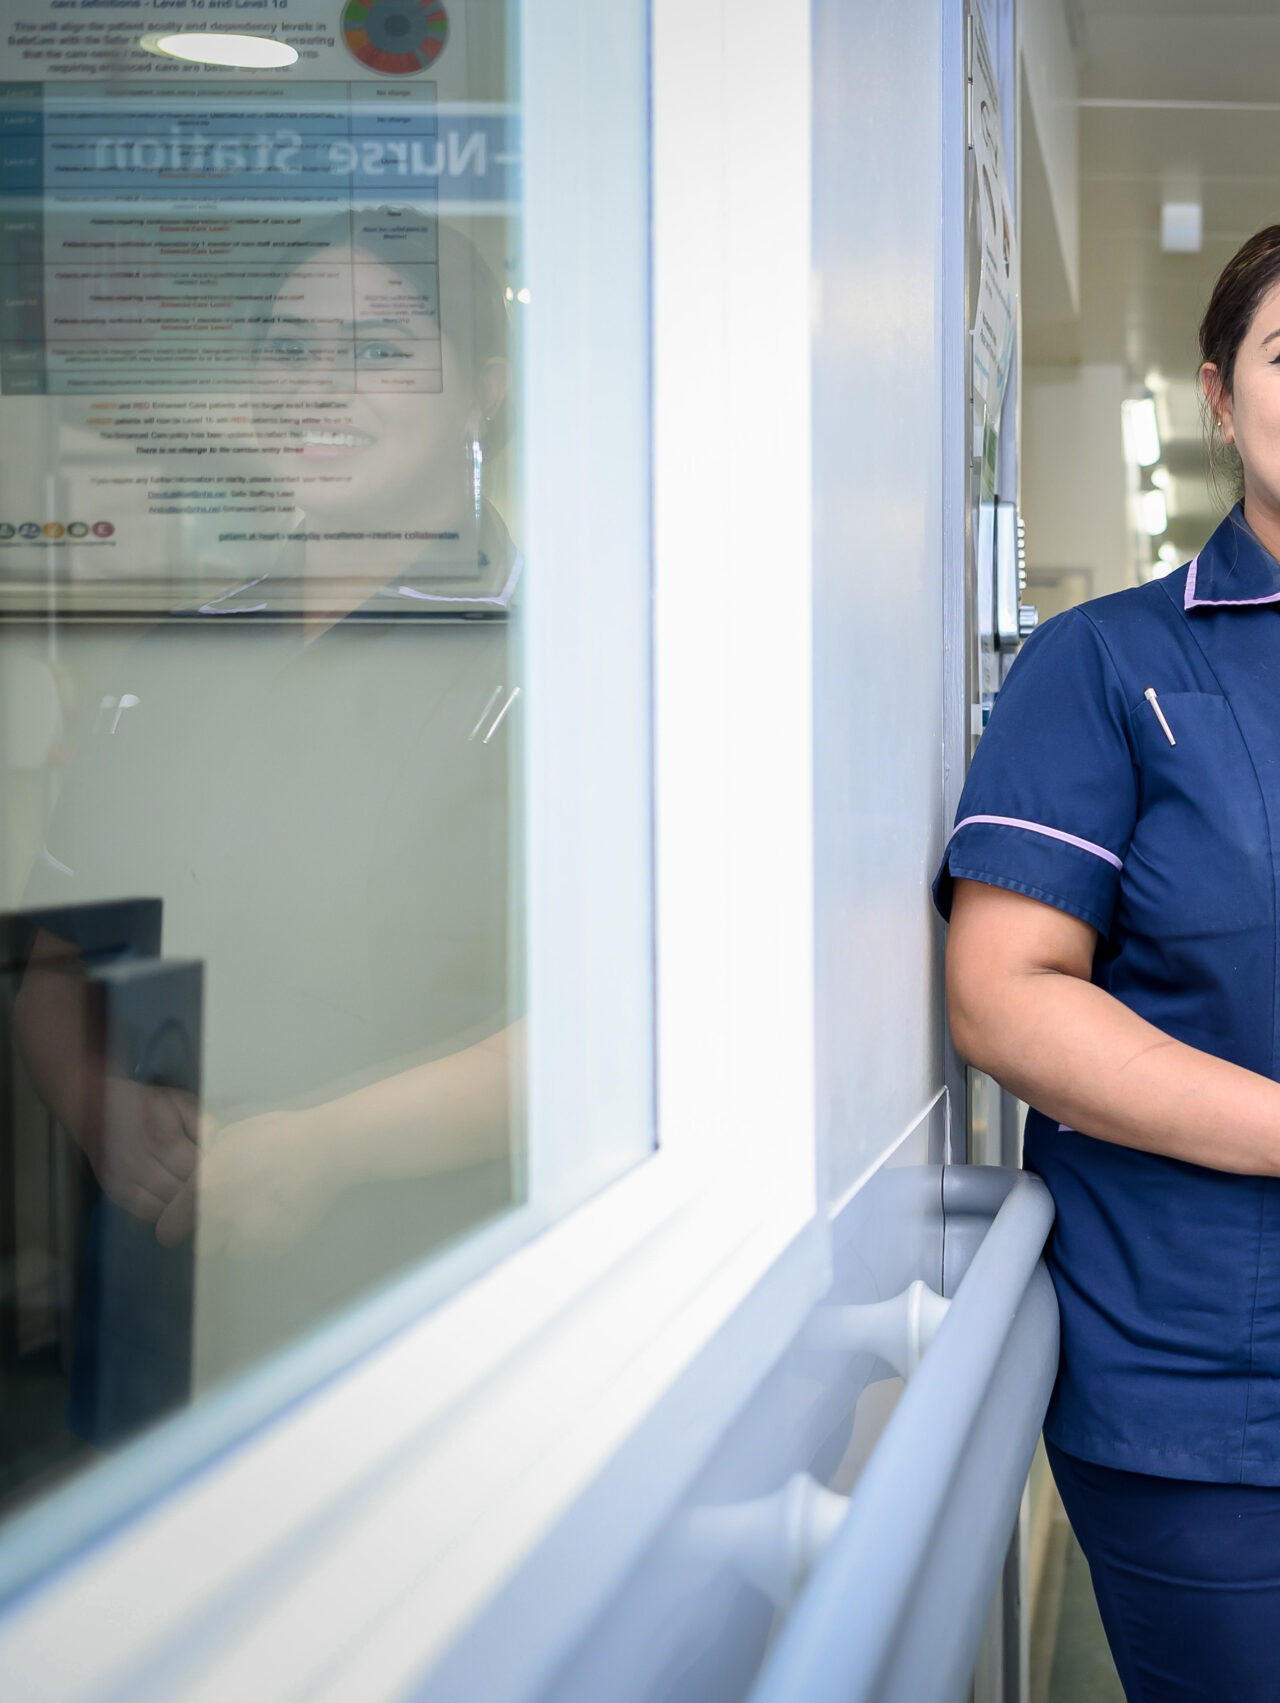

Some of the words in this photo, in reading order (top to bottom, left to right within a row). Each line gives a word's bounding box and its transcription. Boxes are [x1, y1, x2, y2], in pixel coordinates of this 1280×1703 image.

[153, 0, 187, 8] Level
[207, 0, 231, 8] and
[235, 0, 267, 8] Level
[185, 22, 206, 31] and
[210, 22, 277, 33] dependency
[281, 22, 313, 31] levels
